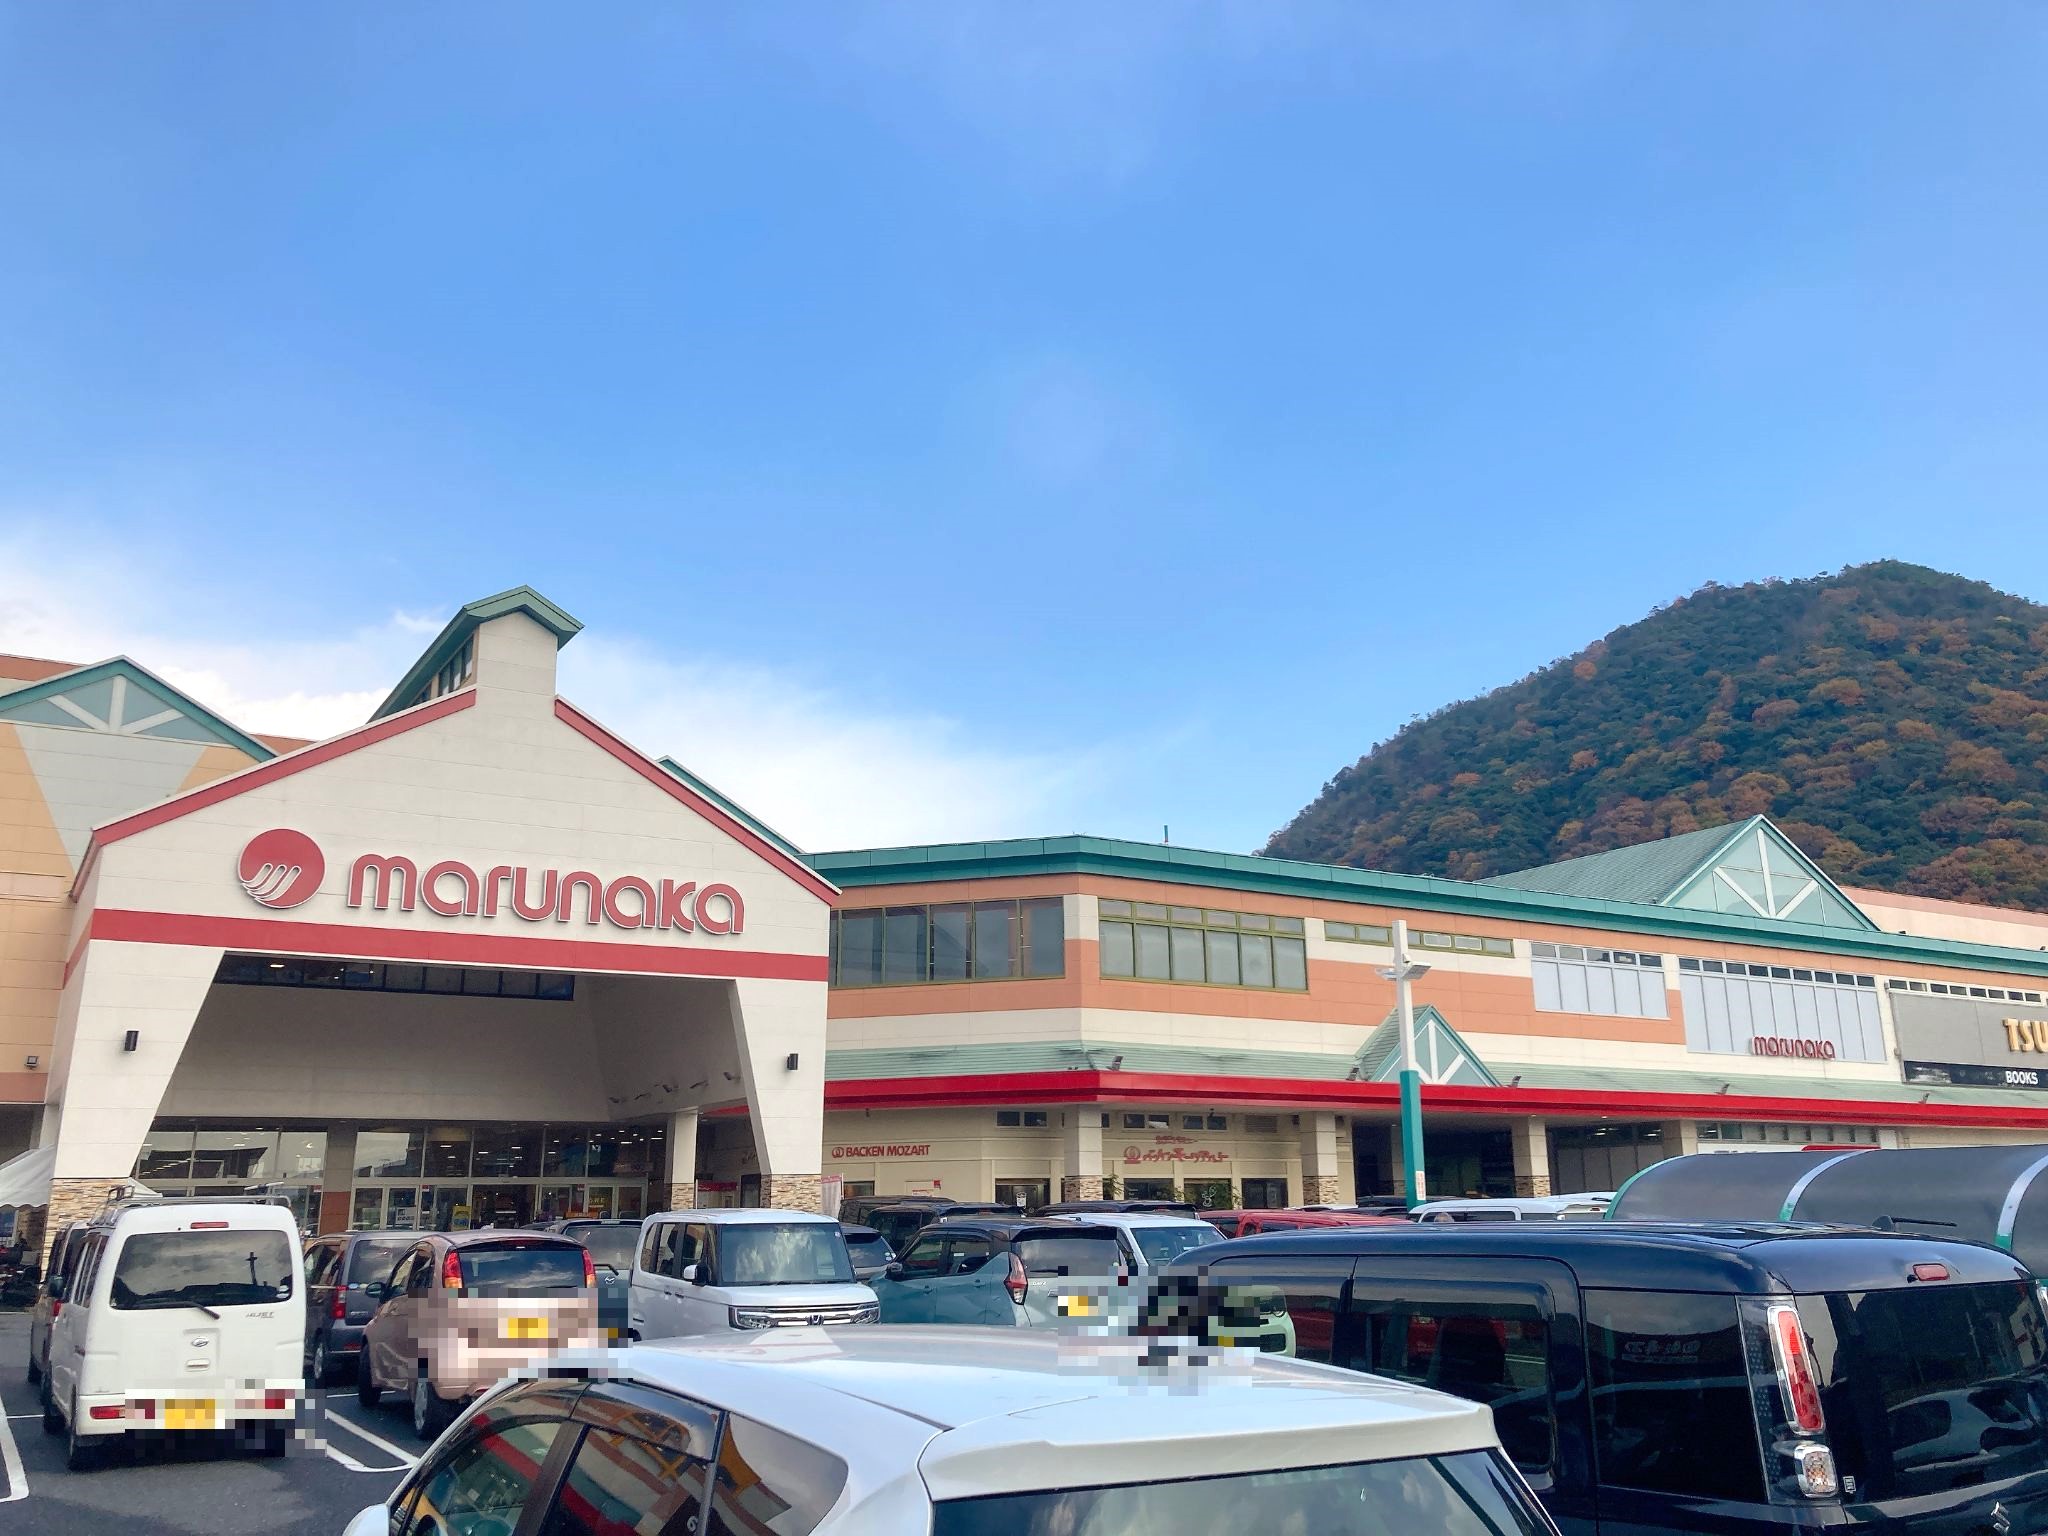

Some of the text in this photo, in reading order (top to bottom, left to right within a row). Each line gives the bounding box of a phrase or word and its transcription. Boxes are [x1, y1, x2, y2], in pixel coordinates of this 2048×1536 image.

[347, 853, 745, 935] marunaka
[2002, 1018, 2048, 1053] TSU
[1753, 1036, 1836, 1059] marunaka
[2005, 1071, 2039, 1085] BOOKS
[846, 1144, 930, 1157] BACKEN MOZART
